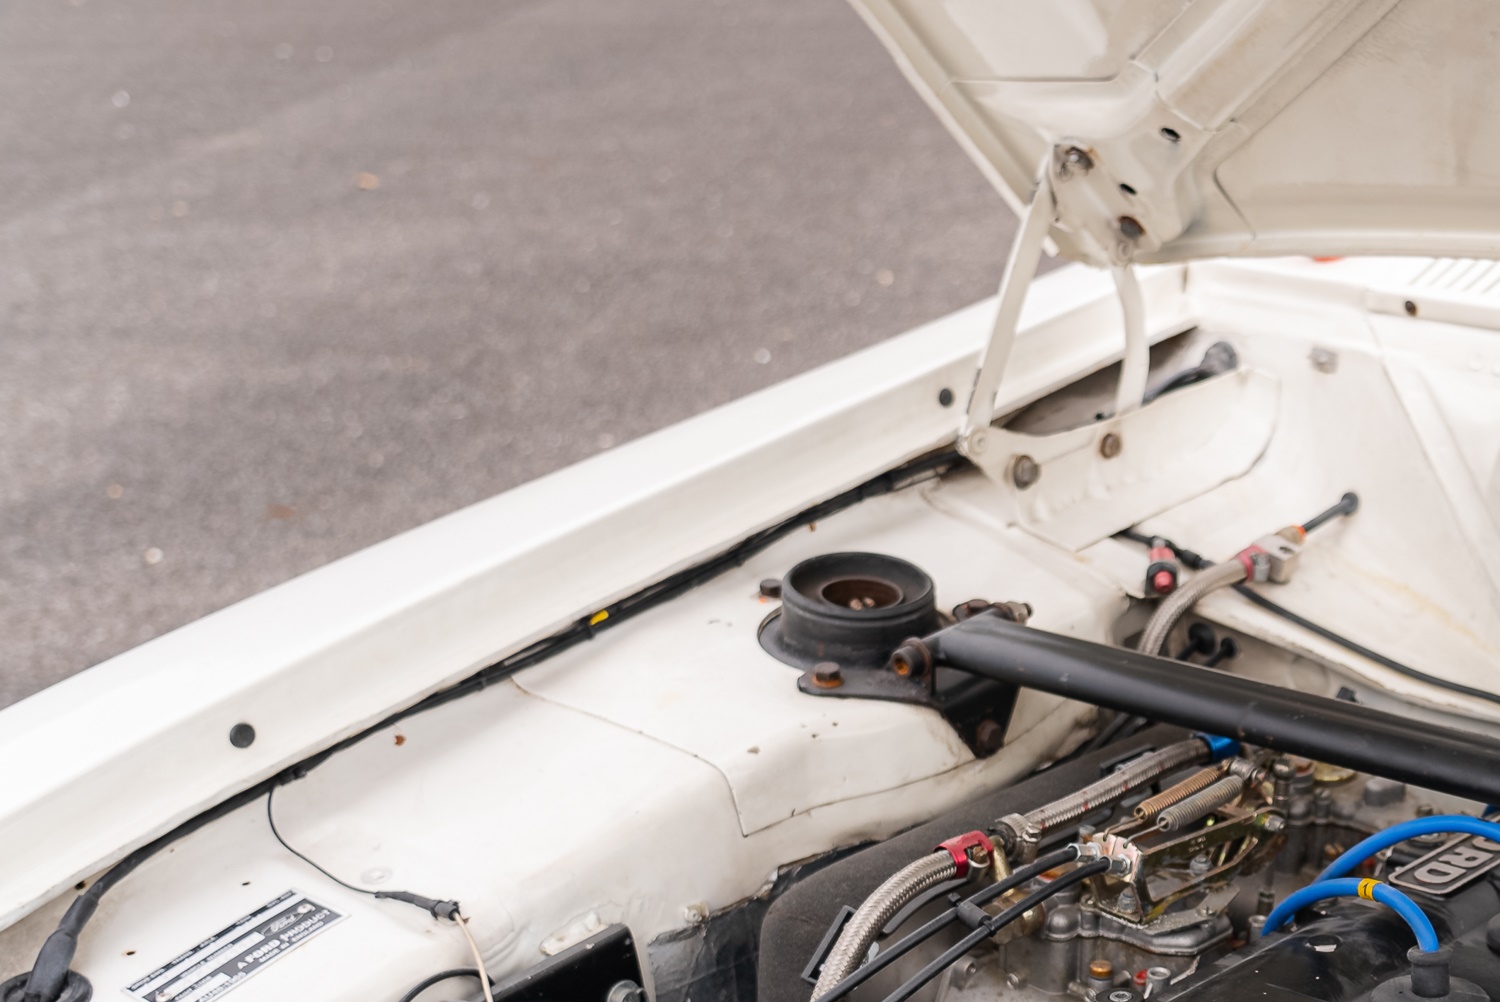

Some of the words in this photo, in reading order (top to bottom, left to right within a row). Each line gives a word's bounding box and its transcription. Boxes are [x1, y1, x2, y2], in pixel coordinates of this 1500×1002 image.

[236, 961, 248, 971] A
[245, 938, 281, 963] FORD
[279, 909, 331, 941] PRODUCT
